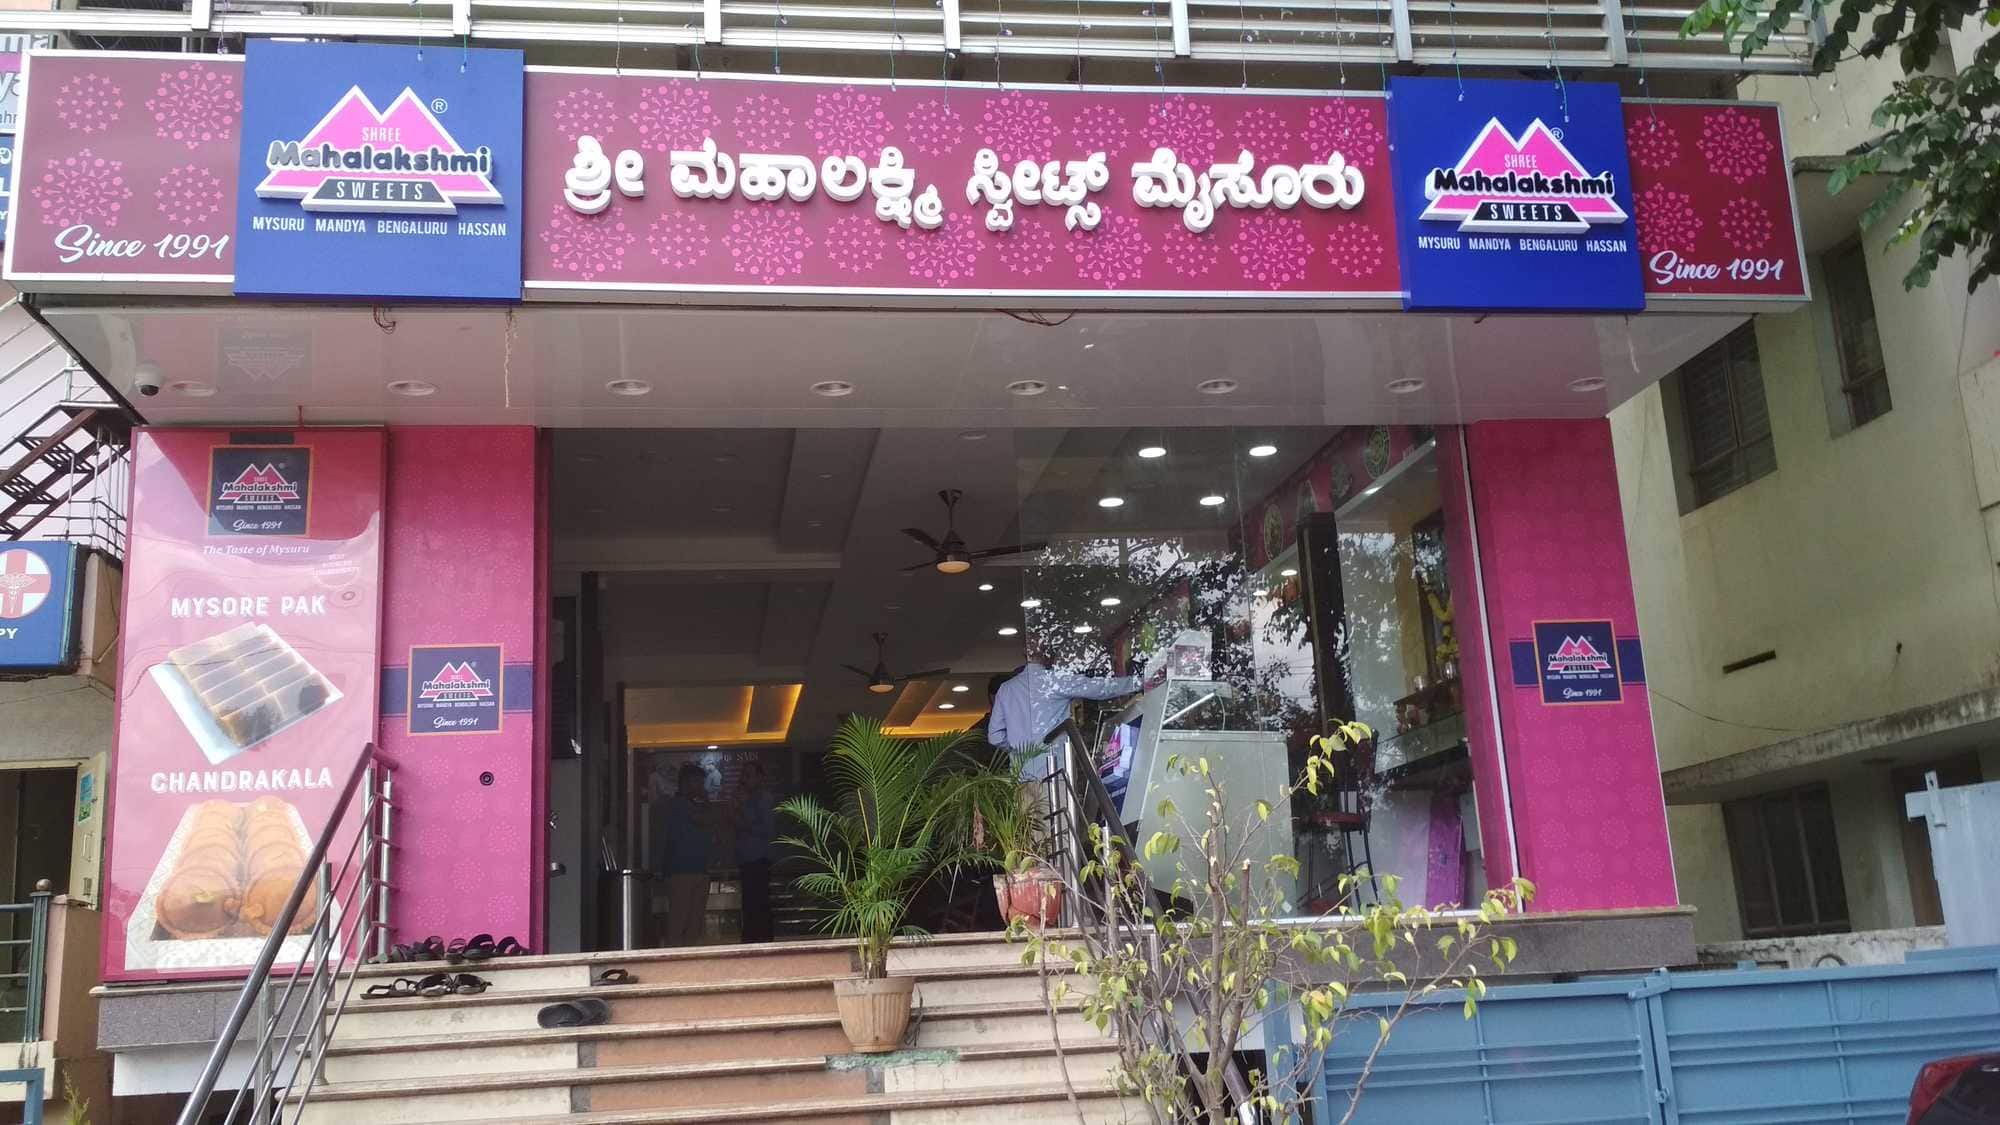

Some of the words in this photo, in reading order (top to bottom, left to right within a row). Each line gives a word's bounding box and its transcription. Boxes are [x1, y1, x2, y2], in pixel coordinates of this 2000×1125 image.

[362, 127, 401, 142] SHREE
[269, 142, 491, 172] Mahalakshmi
[1504, 153, 1538, 168] SHREE
[336, 181, 424, 200] SWEETS
[564, 135, 645, 215] ಶ್ರೀ
[670, 136, 943, 230] ಮಹಾಲಕ್ಷ್ಮಿ
[966, 148, 1110, 232] ಸ್ವೀಟ್ಸ್
[1131, 147, 1366, 233] ಮೈಸೂರು
[1433, 169, 1614, 195] Mahalakshmi
[1490, 203, 1562, 221] SWEETS
[253, 216, 305, 231] MYSURU
[315, 219, 367, 233] MANDYA
[377, 220, 448, 235] BENGALURU
[458, 222, 507, 236] HASSAN
[55, 224, 145, 263] Since
[153, 233, 229, 261] 1991
[1418, 236, 1461, 250] MYSURU
[1469, 238, 1511, 251] MANDYA
[1519, 238, 1578, 252] BENGALURU
[1586, 239, 1627, 253] HASSAN
[1649, 249, 1720, 285] Since
[1725, 257, 1784, 282] 1991
[222, 482, 297, 492] Mahalakshmi
[233, 519, 259, 531] Since
[261, 521, 282, 529] 1991
[203, 545, 223, 555] The
[227, 545, 254, 555] Taste
[256, 545, 267, 556] of
[271, 544, 310, 555] Mysuru
[171, 596, 270, 618] MYSORE
[280, 594, 326, 616] PAK
[1548, 652, 1608, 662] Mahalakshmi
[422, 679, 490, 691] Mahalakshmi
[1585, 688, 1602, 696] 1991
[433, 716, 457, 728] Since
[460, 717, 478, 726] 1991
[151, 767, 334, 793] CHANDRAKALA
